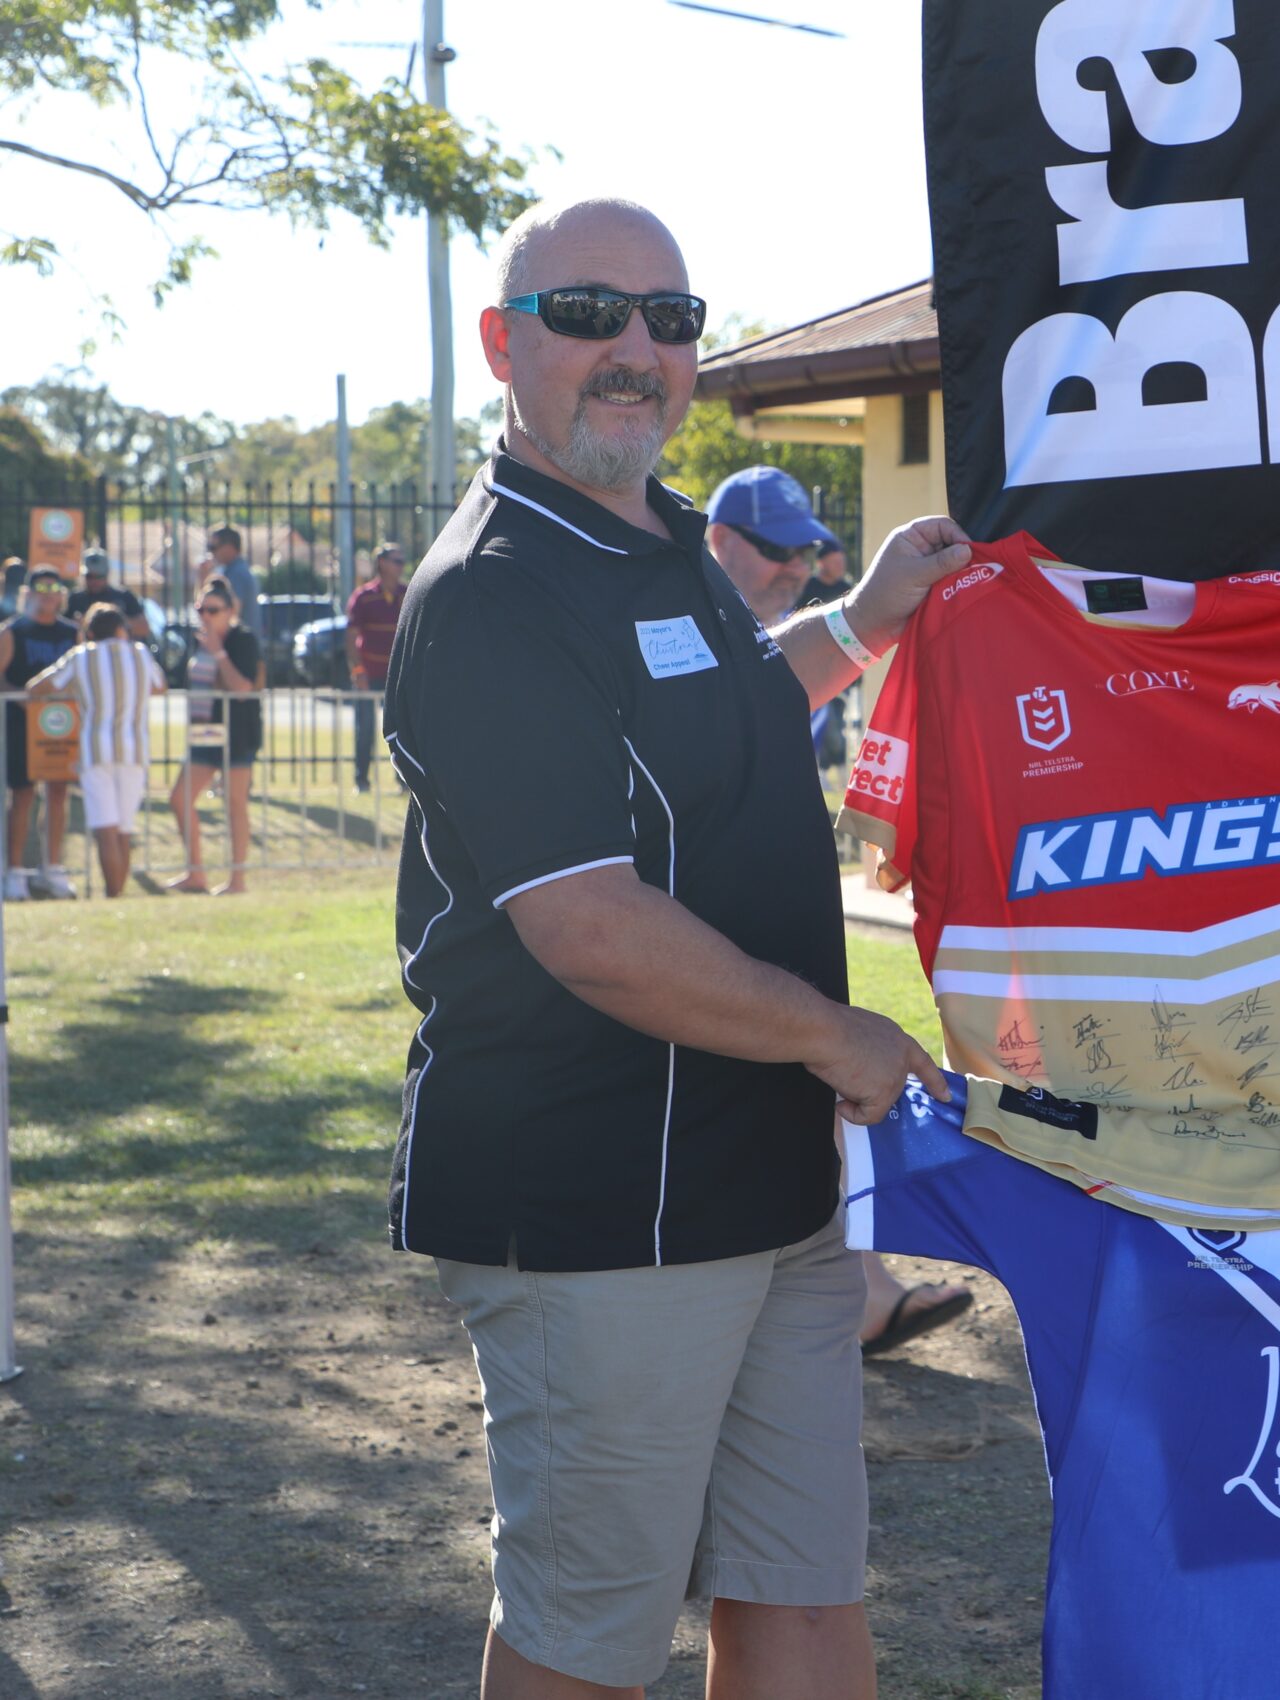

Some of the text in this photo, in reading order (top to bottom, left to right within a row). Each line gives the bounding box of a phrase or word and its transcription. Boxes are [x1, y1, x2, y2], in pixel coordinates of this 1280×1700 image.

[942, 567, 990, 601] CLASSIC
[1106, 669, 1195, 697] COVE
[1022, 761, 1084, 778] PREMIERSHIP
[1044, 755, 1076, 767] TELSTRA
[1187, 1261, 1254, 1271] PREMIERSHIP
